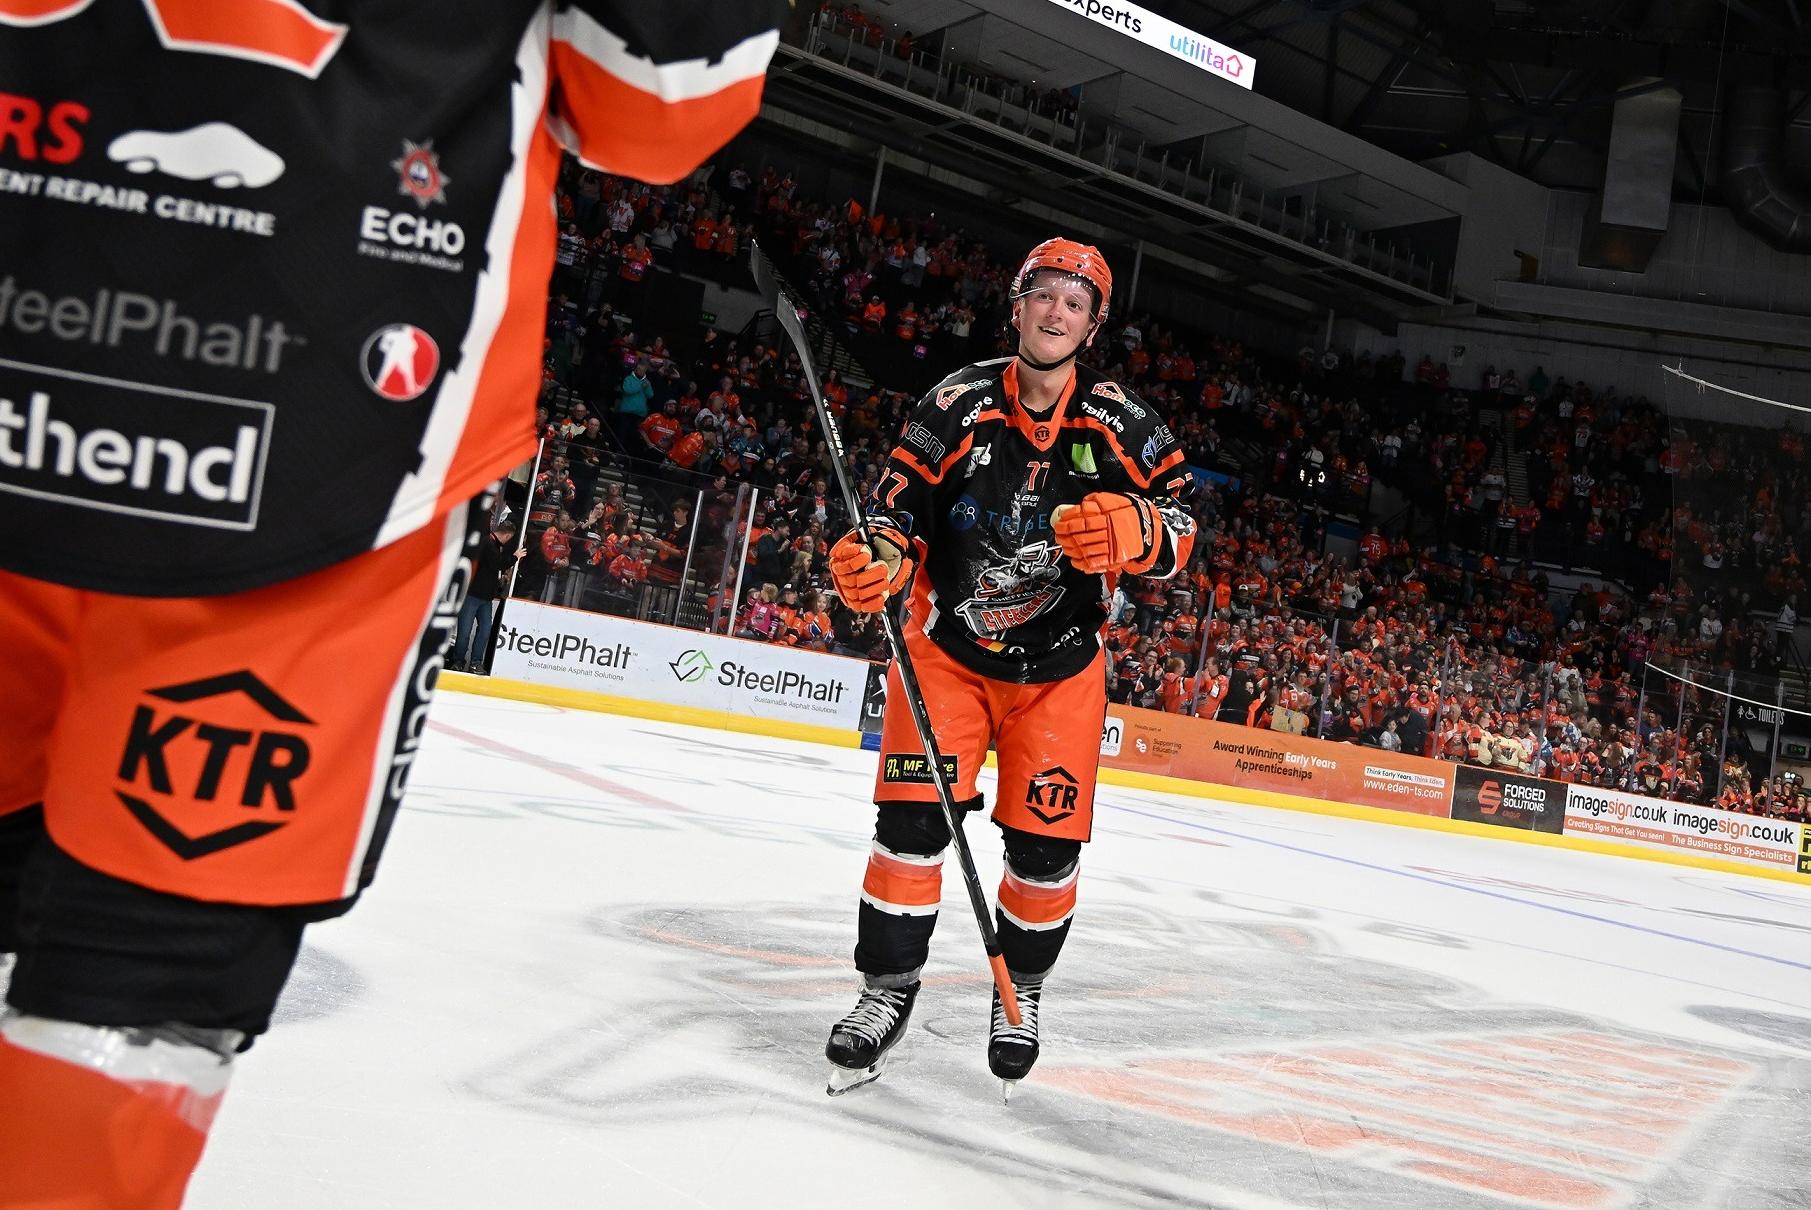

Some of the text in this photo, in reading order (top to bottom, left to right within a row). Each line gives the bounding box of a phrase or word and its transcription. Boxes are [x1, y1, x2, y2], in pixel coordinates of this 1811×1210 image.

[1065, 0, 1142, 33] xperts
[1170, 33, 1225, 71] utilita
[45, 175, 149, 214] REPAIR
[154, 195, 276, 236] CENTRE
[361, 205, 465, 255] ECHO
[528, 660, 625, 680] Sustainable Asphalt Solutions
[754, 696, 838, 714] Sustainable Asphalt Solutions
[1758, 708, 1785, 725] TOILES
[1153, 738, 1182, 749] Supporting
[1153, 745, 1178, 755] Education
[119, 704, 310, 812] KTR
[903, 759, 924, 771] MF
[1213, 740, 1337, 770] Award Winning Early Years
[1235, 758, 1313, 781] Apprenticeships
[1366, 767, 1381, 775] Think
[1382, 770, 1396, 779] Early
[1026, 778, 1079, 811] KTR
[1363, 779, 1443, 800] www.eden-ts.com
[1504, 783, 1546, 802] FORGED
[1503, 797, 1545, 813] SOLUTIONS
[1567, 818, 1594, 831] Creating
[1594, 821, 1610, 833] Signs
[1610, 824, 1625, 835] That
[1625, 827, 1636, 836] Get
[1636, 829, 1648, 838] You
[1568, 790, 1668, 823] imagesign.co.uk
[1673, 808, 1795, 845] imagesign.co.uk
[1671, 834, 1793, 862] The Business Sign Specialists
